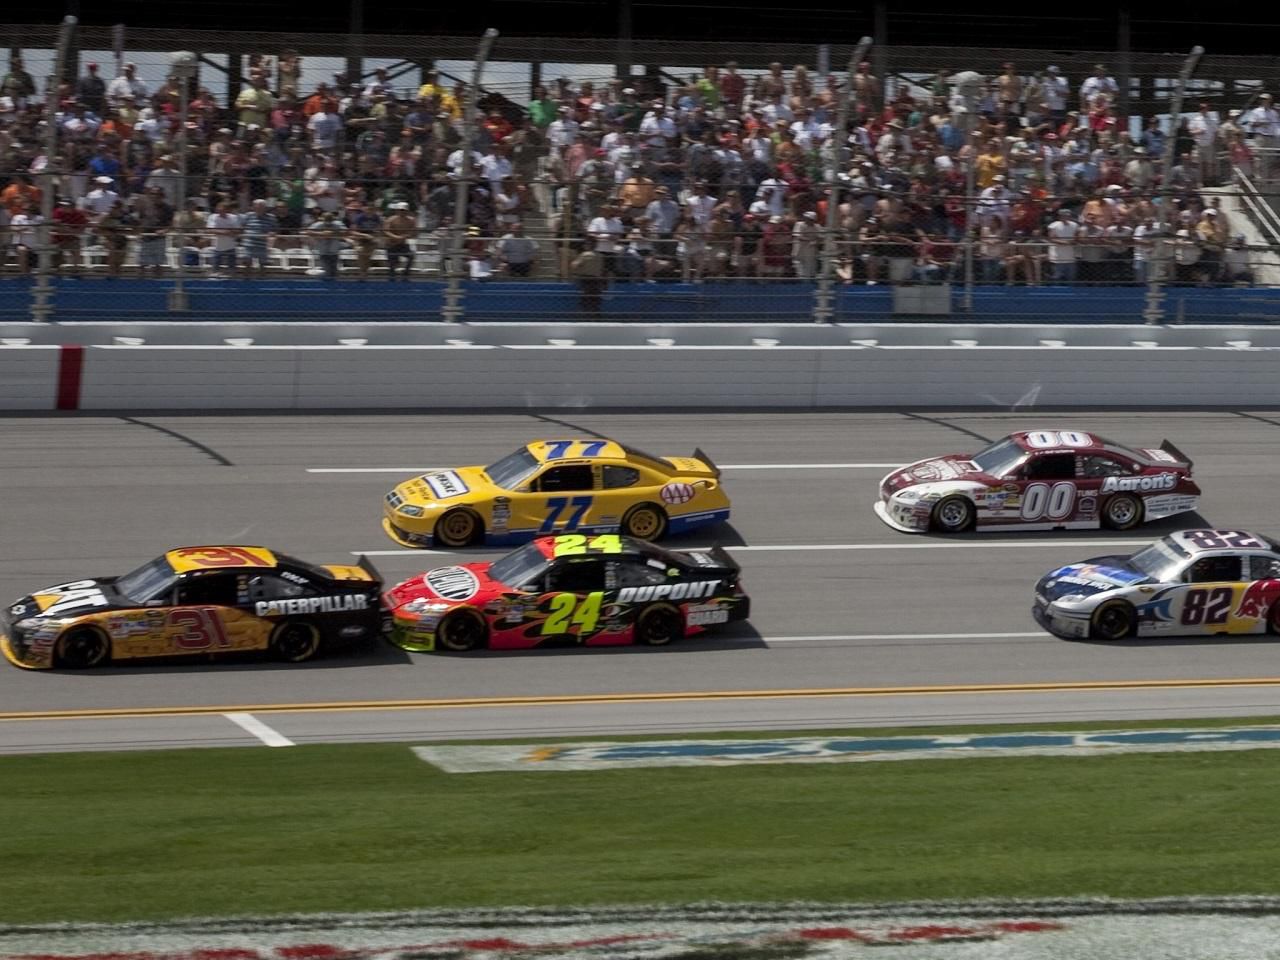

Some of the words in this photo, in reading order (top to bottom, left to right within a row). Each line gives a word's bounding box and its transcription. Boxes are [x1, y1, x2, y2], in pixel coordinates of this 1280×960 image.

[545, 441, 606, 459] 77
[1025, 431, 1093, 448] 00
[1103, 474, 1176, 492] Aaron's
[1021, 481, 1076, 521] 00
[539, 496, 593, 534] 77
[554, 534, 622, 555] 24
[1183, 530, 1266, 548] 82
[179, 547, 271, 567] 31
[31, 579, 109, 618] CAT
[616, 580, 721, 603] DUPONT
[255, 593, 368, 617] CATERPILLAR
[541, 591, 604, 634] 24
[1181, 588, 1233, 625] 82
[166, 605, 231, 650] 31
